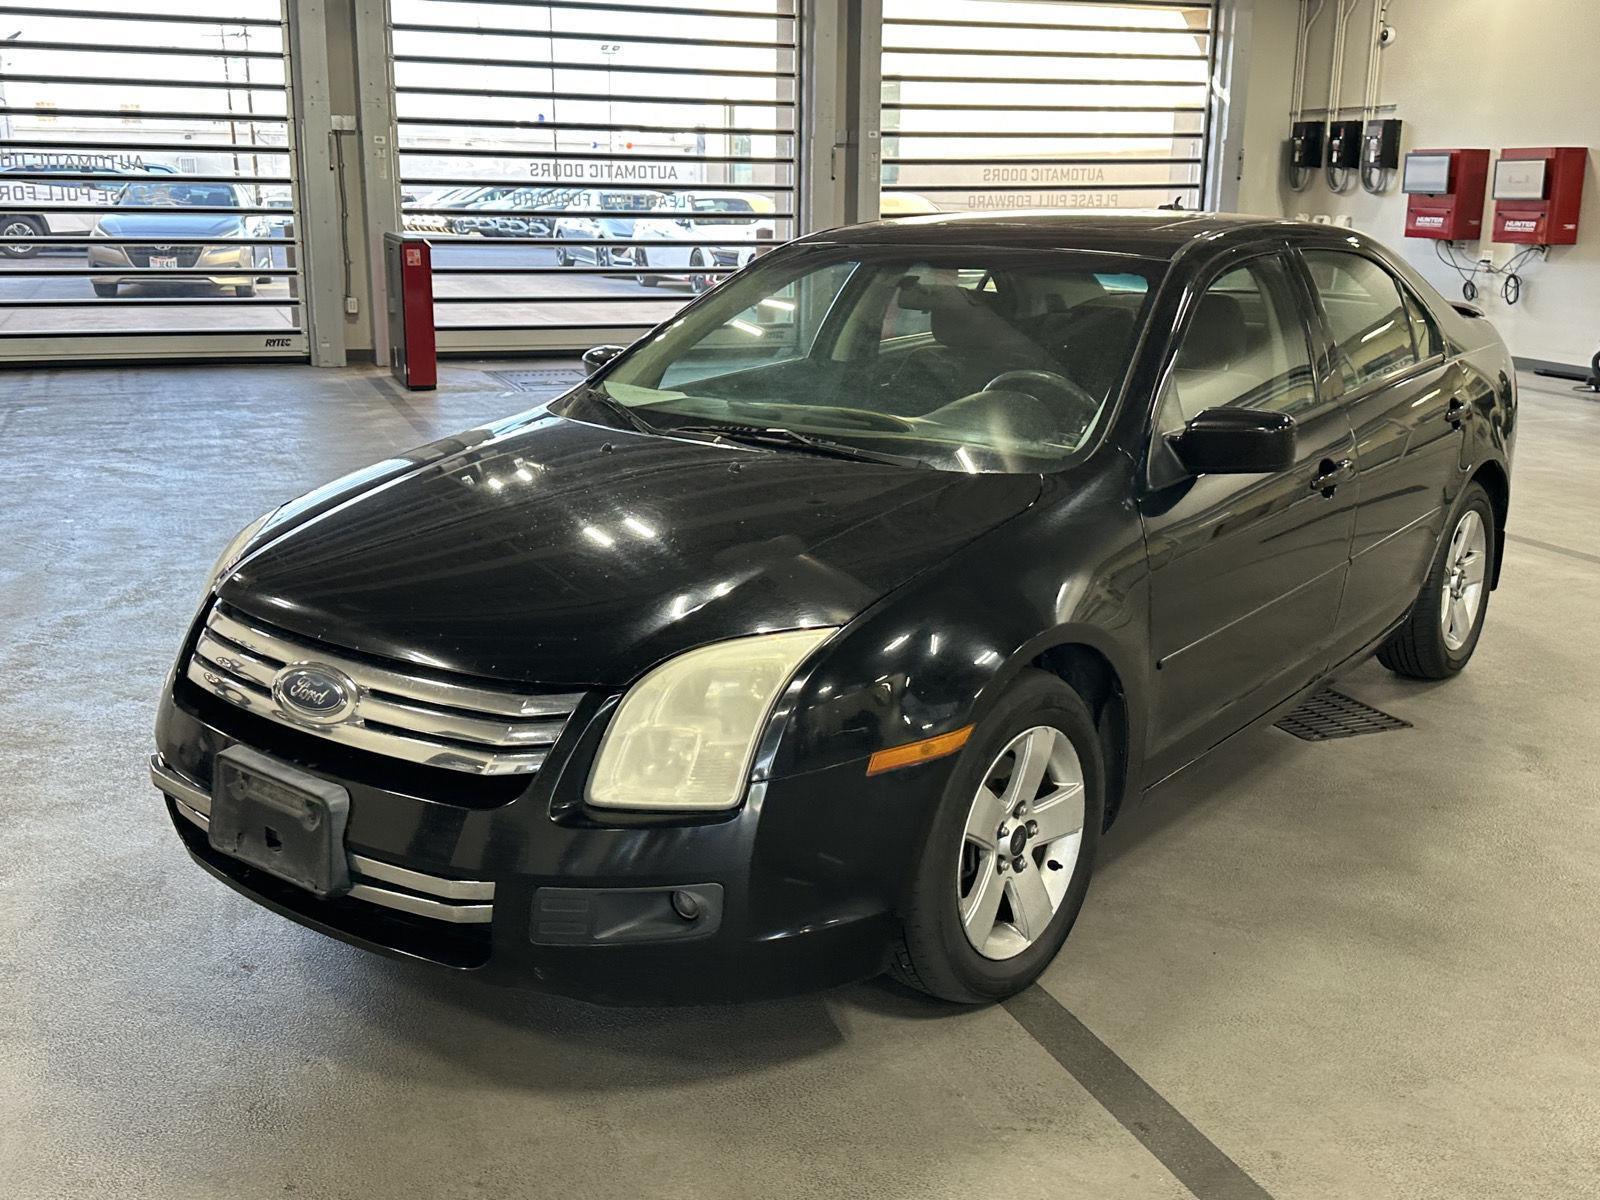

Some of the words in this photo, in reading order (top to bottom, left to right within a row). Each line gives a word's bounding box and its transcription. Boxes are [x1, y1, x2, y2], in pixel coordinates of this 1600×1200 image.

[1417, 216, 1444, 224] HUNTER
[1505, 220, 1536, 229] HUNTER
[265, 338, 291, 347] RYTEC
[290, 676, 330, 705] Ford
